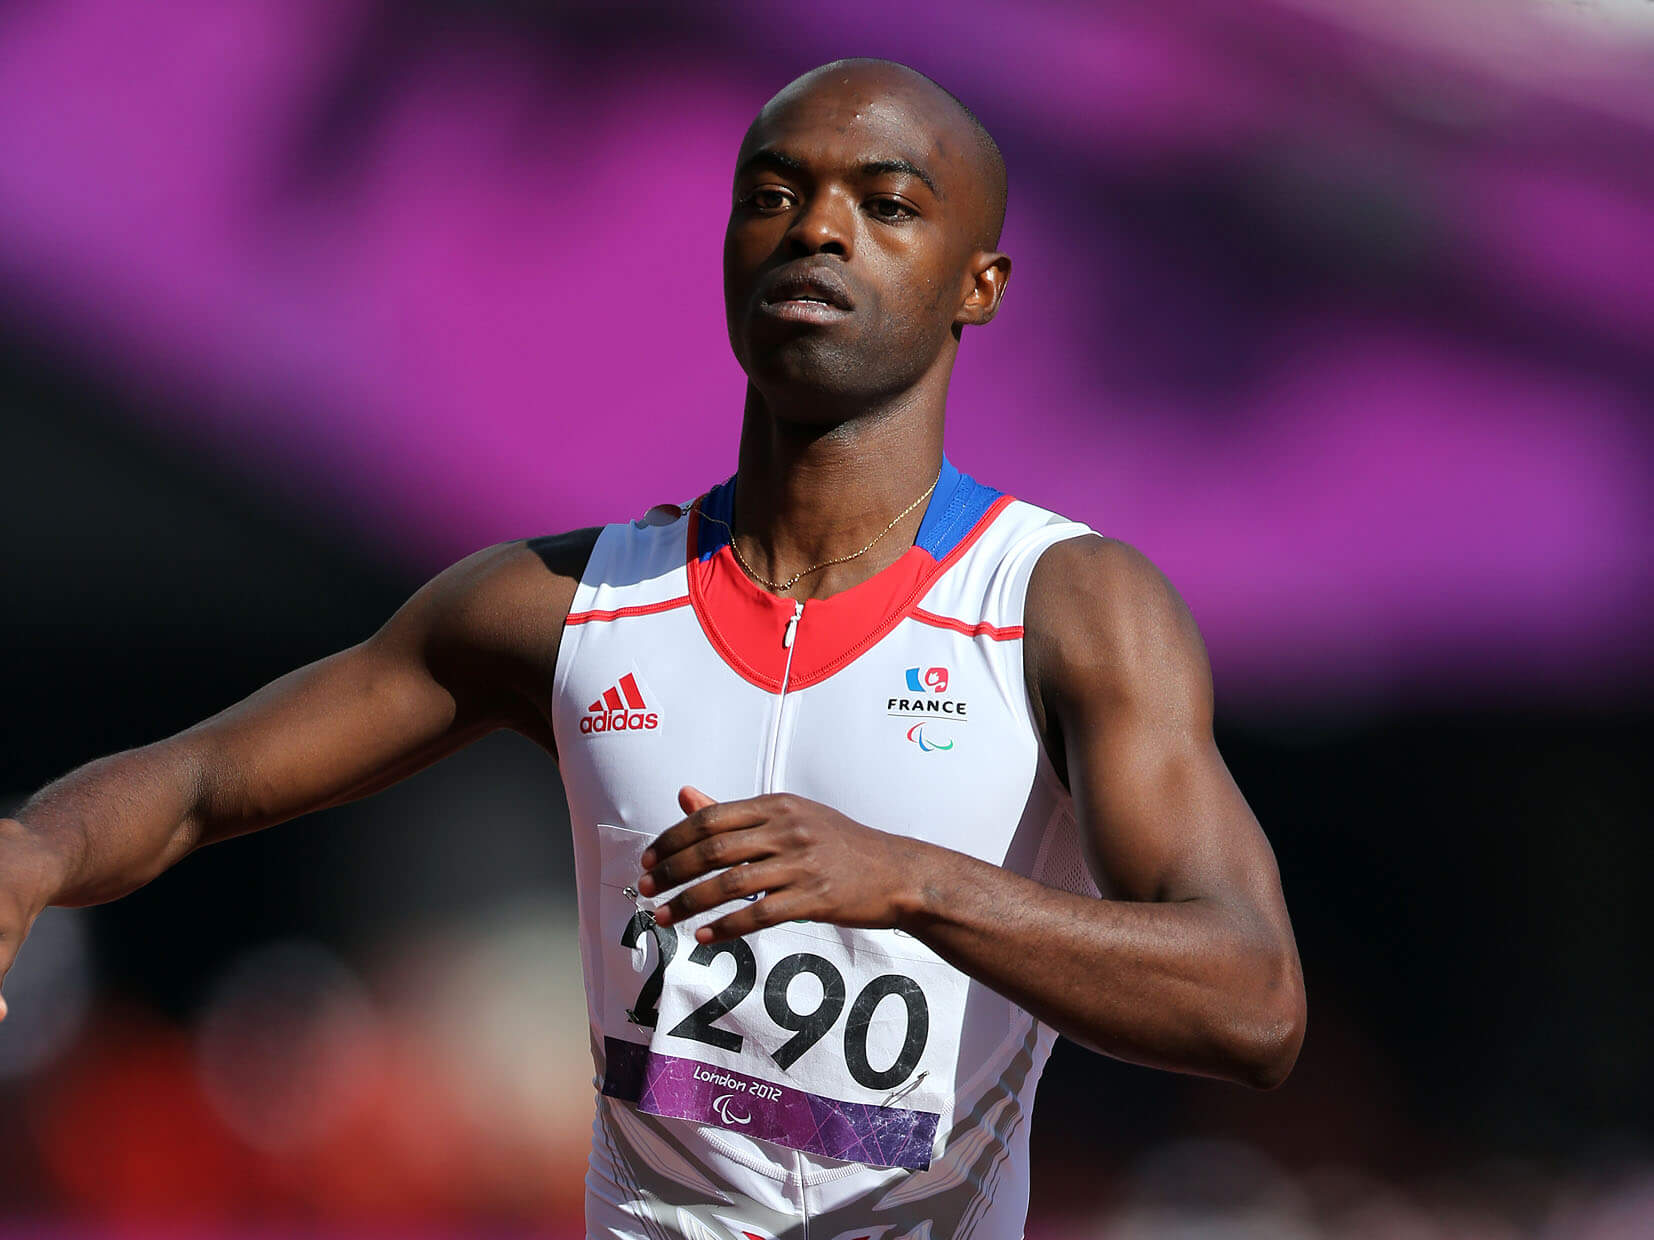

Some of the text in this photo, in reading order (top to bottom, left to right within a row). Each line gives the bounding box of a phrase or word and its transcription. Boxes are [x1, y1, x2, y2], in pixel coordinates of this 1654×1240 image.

[579, 709, 659, 734] adidas
[887, 698, 967, 715] FRANCE
[620, 909, 929, 1090] 2290
[693, 1066, 783, 1102] London 2012
